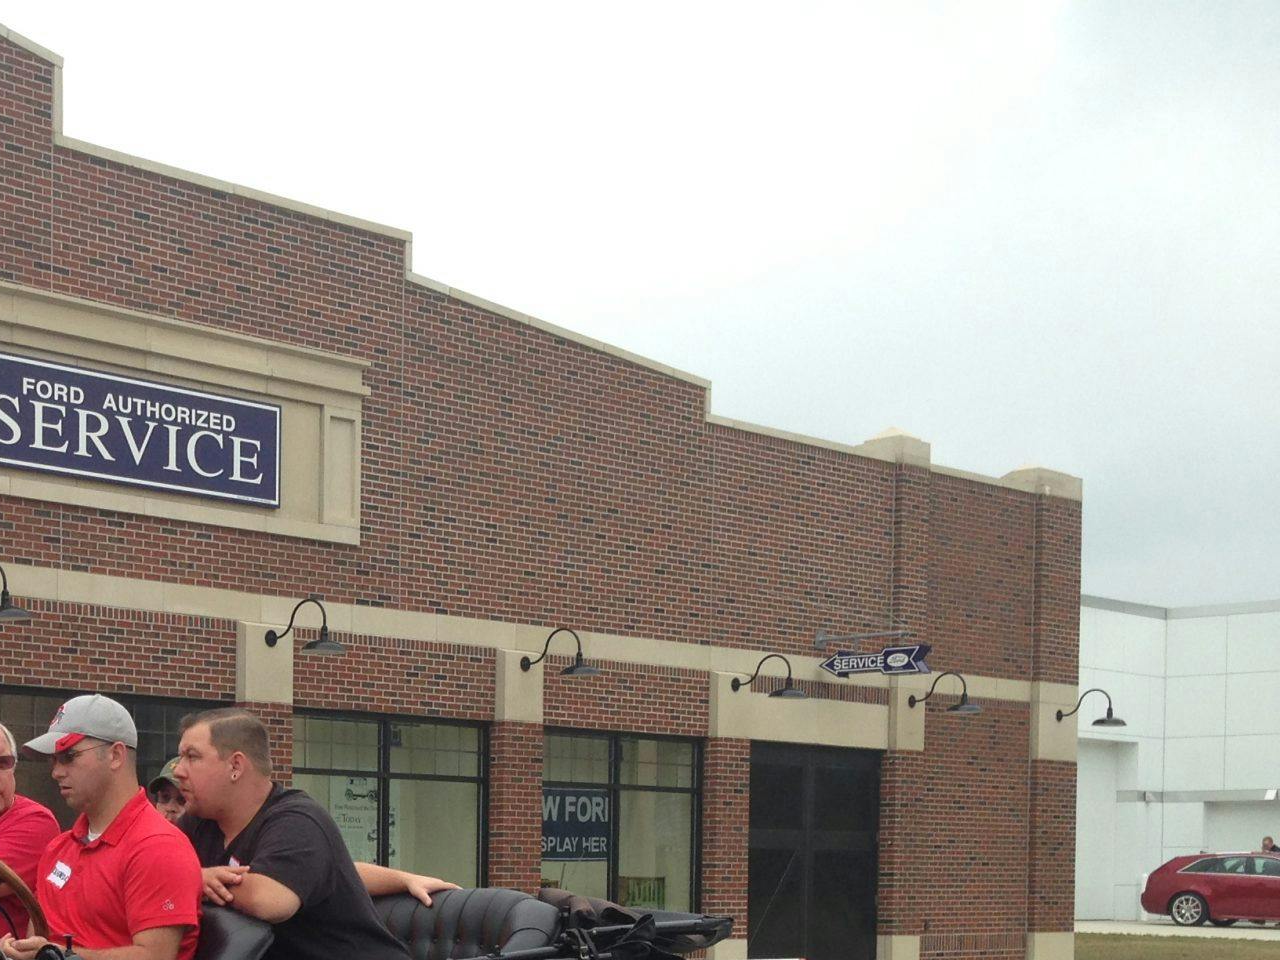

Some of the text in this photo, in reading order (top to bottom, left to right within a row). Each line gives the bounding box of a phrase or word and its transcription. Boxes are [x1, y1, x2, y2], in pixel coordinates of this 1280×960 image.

[22, 377, 236, 432] FORD AUTHORIZED
[833, 656, 885, 670] SERVICE
[542, 795, 560, 821] W
[541, 836, 608, 852] SPLAY HER
